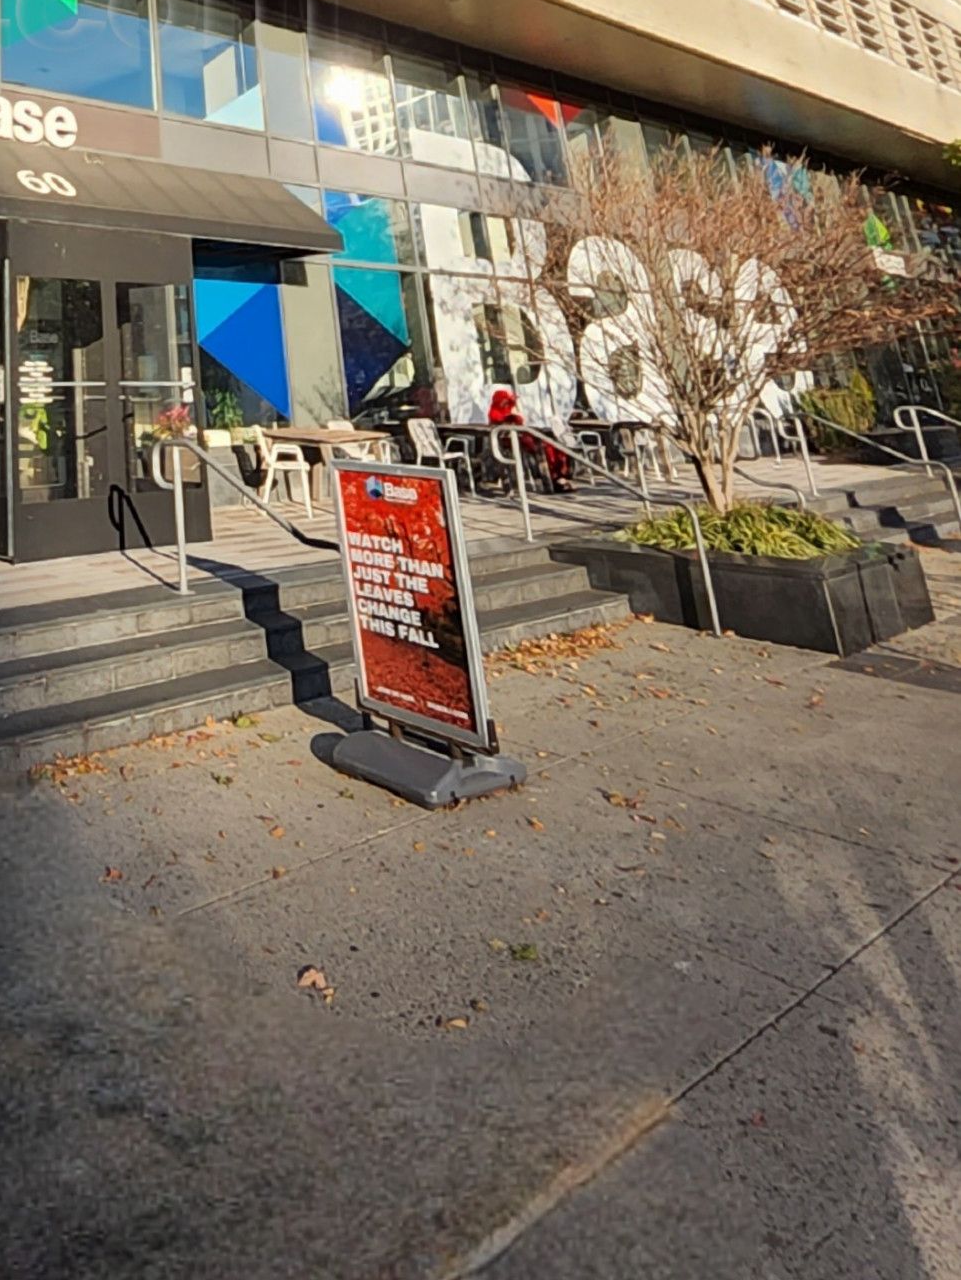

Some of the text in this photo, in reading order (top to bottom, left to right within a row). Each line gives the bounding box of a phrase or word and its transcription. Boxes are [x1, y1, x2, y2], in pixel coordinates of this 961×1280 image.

[17, 170, 76, 197] 60
[347, 532, 404, 554] WATCH
[350, 548, 444, 578] MORE THAN
[353, 565, 429, 594] JUST THE
[355, 581, 414, 607] LEAVES
[358, 598, 422, 626] CHANGE
[359, 614, 439, 648] THIS FALL
